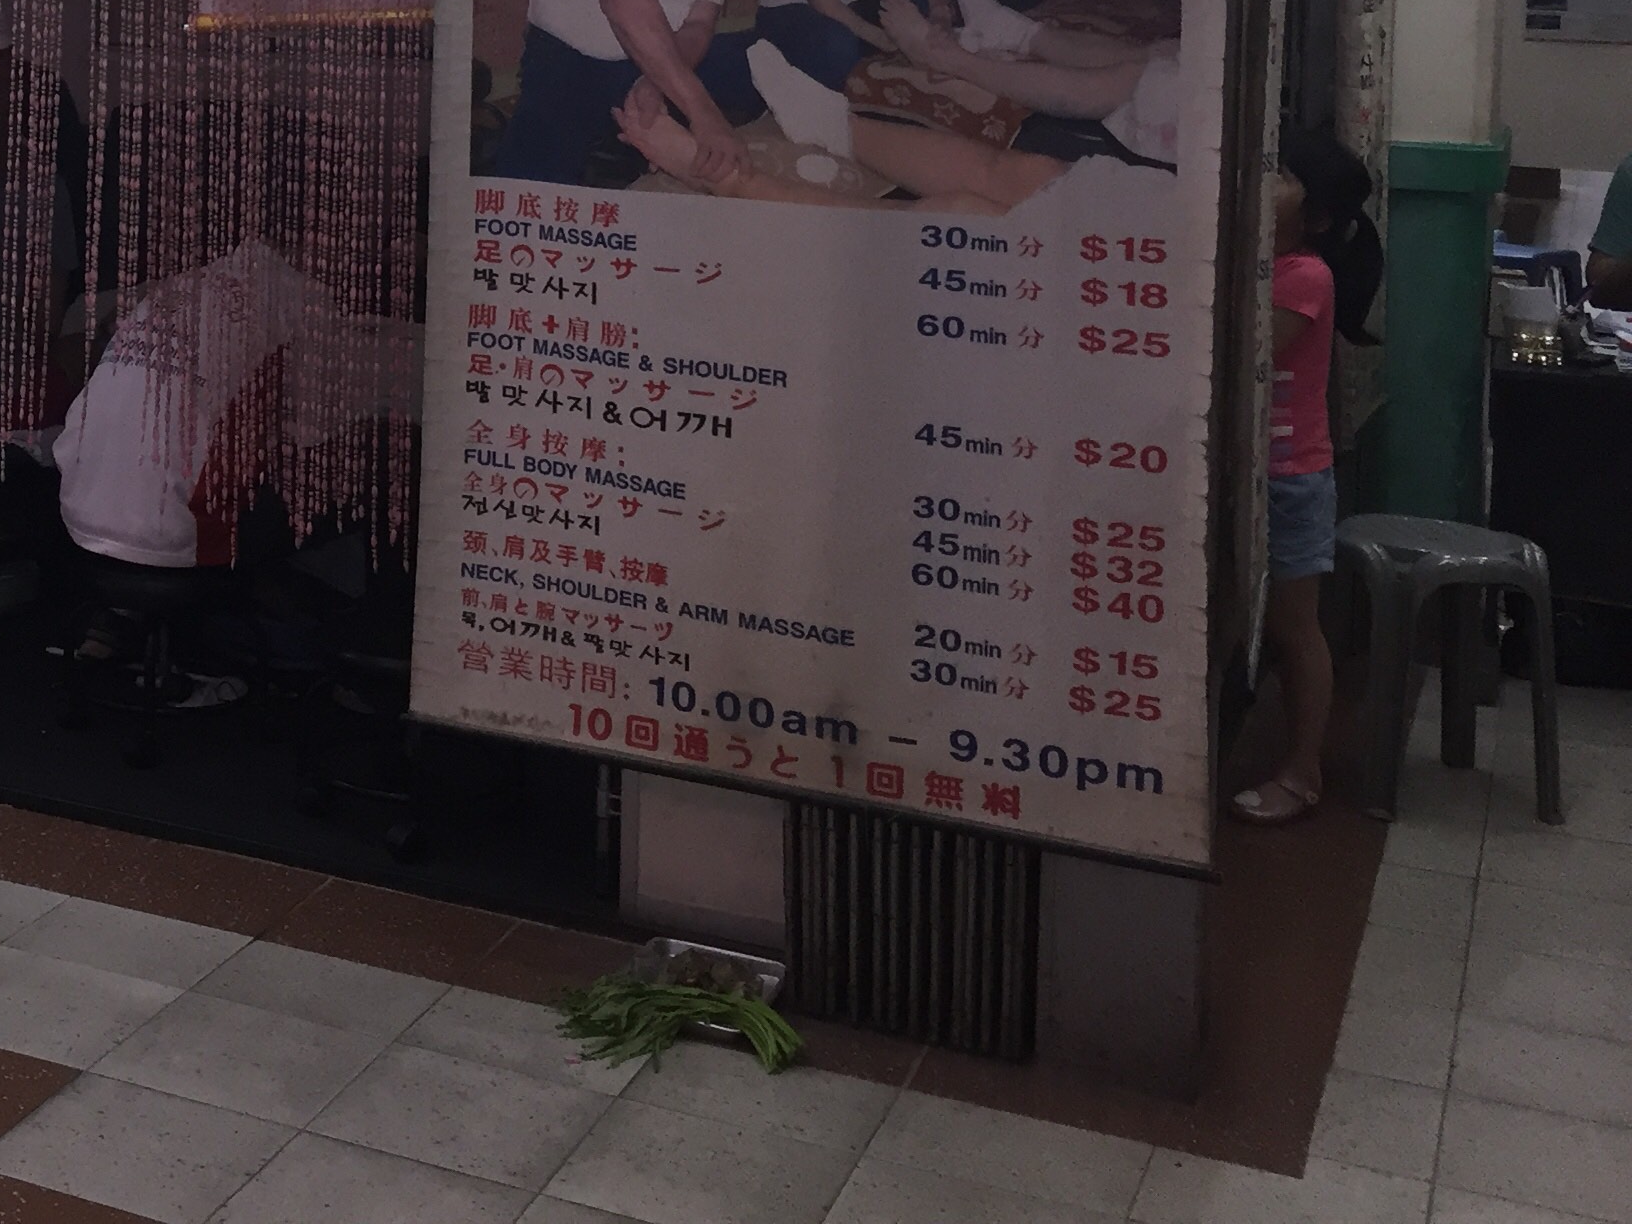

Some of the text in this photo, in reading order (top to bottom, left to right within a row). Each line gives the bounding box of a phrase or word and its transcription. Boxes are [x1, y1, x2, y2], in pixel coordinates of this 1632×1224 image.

[474, 188, 621, 228] 脚底按摩
[474, 218, 637, 252] FOOT MASSAGE
[467, 332, 788, 388] FOOT MASSAGE & SHOULDER
[602, 401, 623, 427] &
[464, 448, 687, 500] FULL BODY MASSAGE
[461, 562, 855, 648] NECK, SHOULDER & ARM MASSAGE
[649, 676, 858, 745] 10.00am
[948, 728, 1164, 795] 9.30pm
